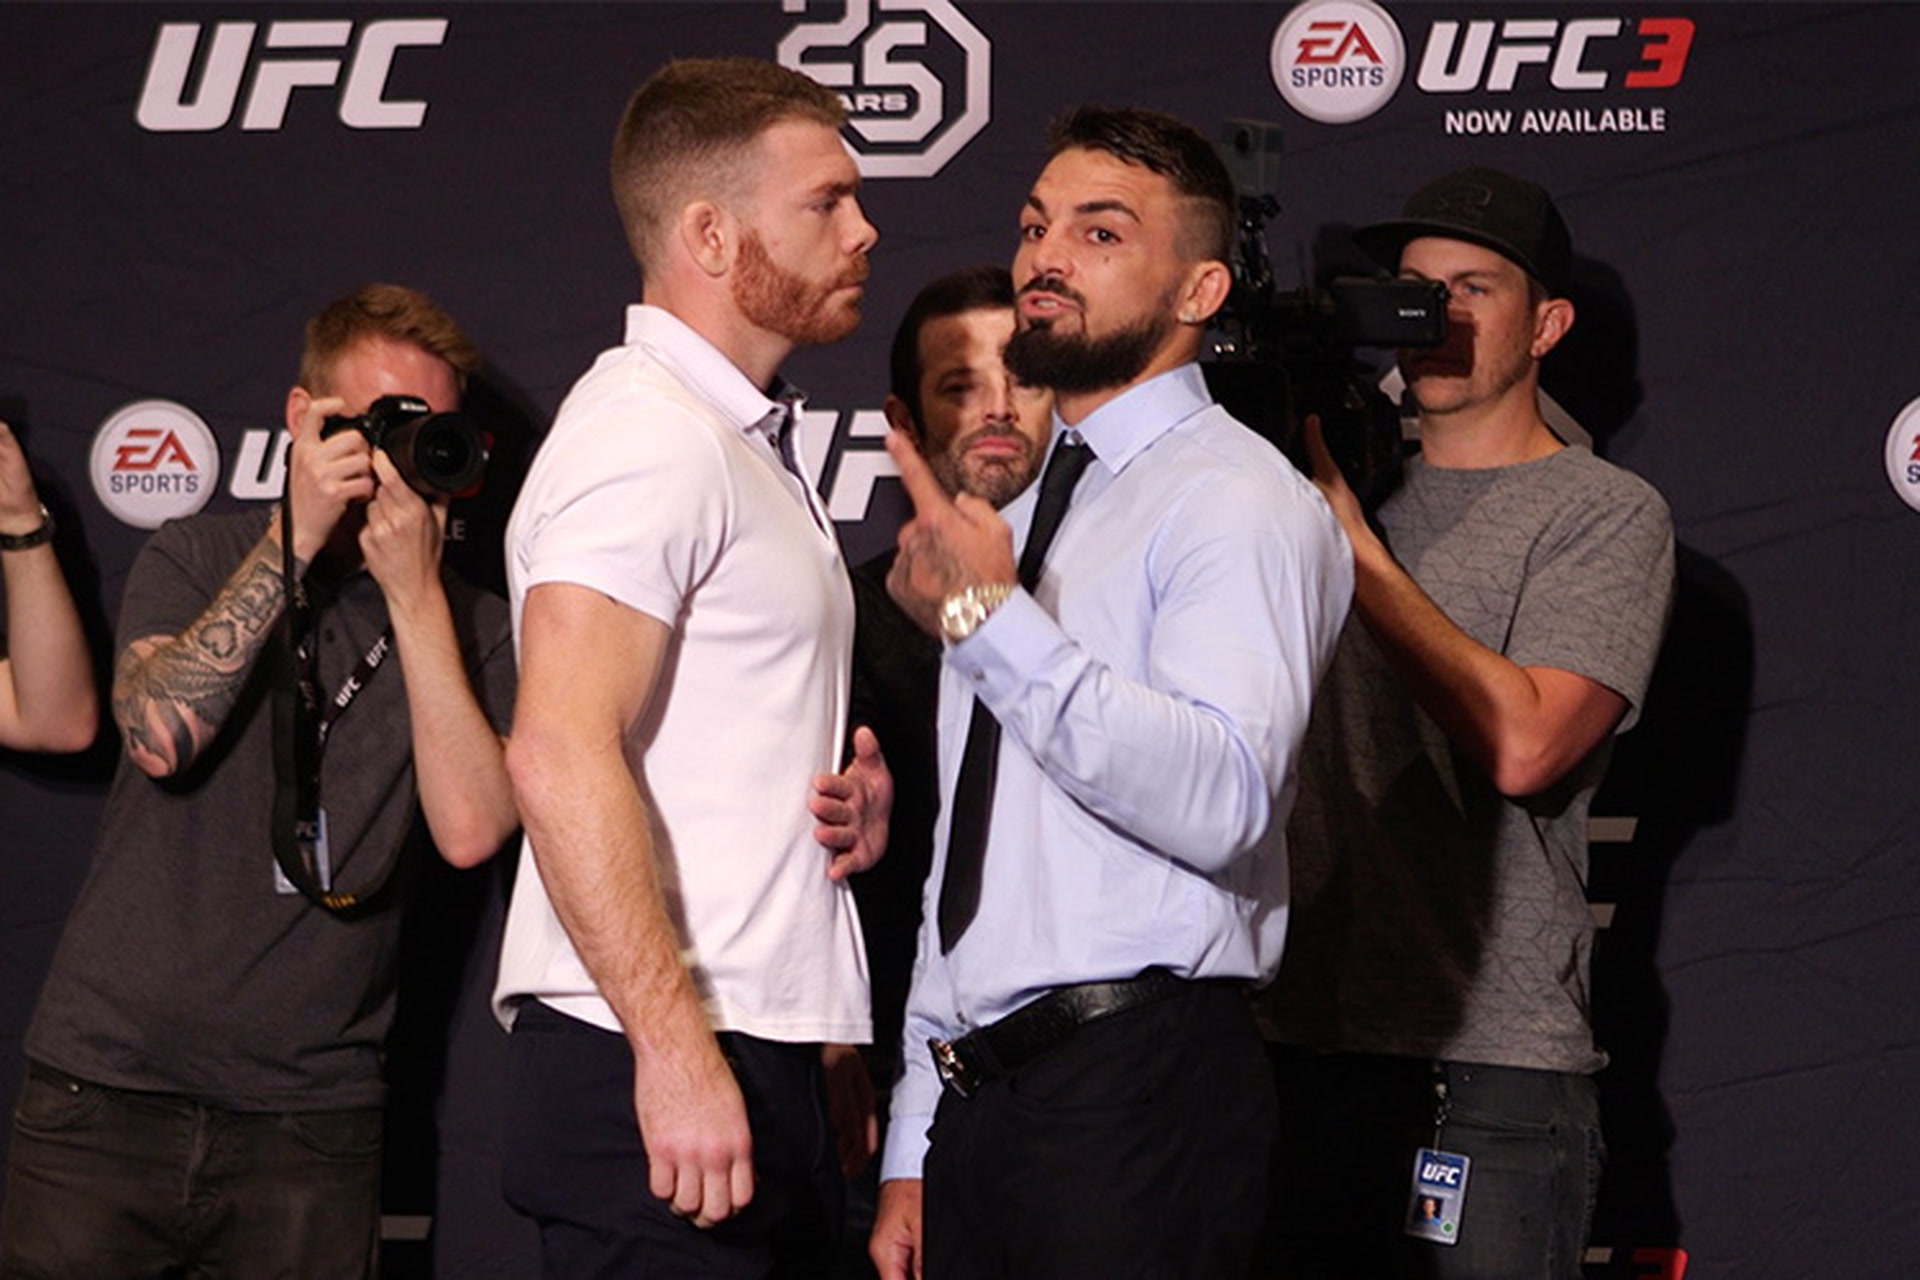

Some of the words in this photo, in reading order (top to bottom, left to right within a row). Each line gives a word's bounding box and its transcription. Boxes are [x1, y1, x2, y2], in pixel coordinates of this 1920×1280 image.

[1295, 22, 1382, 64] EA
[1416, 18, 1622, 92] UFC
[1624, 18, 1696, 88] 3
[136, 19, 449, 131] UFC
[1291, 66, 1384, 88] SPORTS
[837, 93, 908, 111] ARS
[1444, 110, 1512, 134] NOW
[1521, 109, 1666, 133] AVAILABLE
[112, 429, 197, 471] EA
[110, 474, 200, 493] SPORTS
[335, 677, 361, 708] UFC
[1422, 1162, 1461, 1185] UFC
